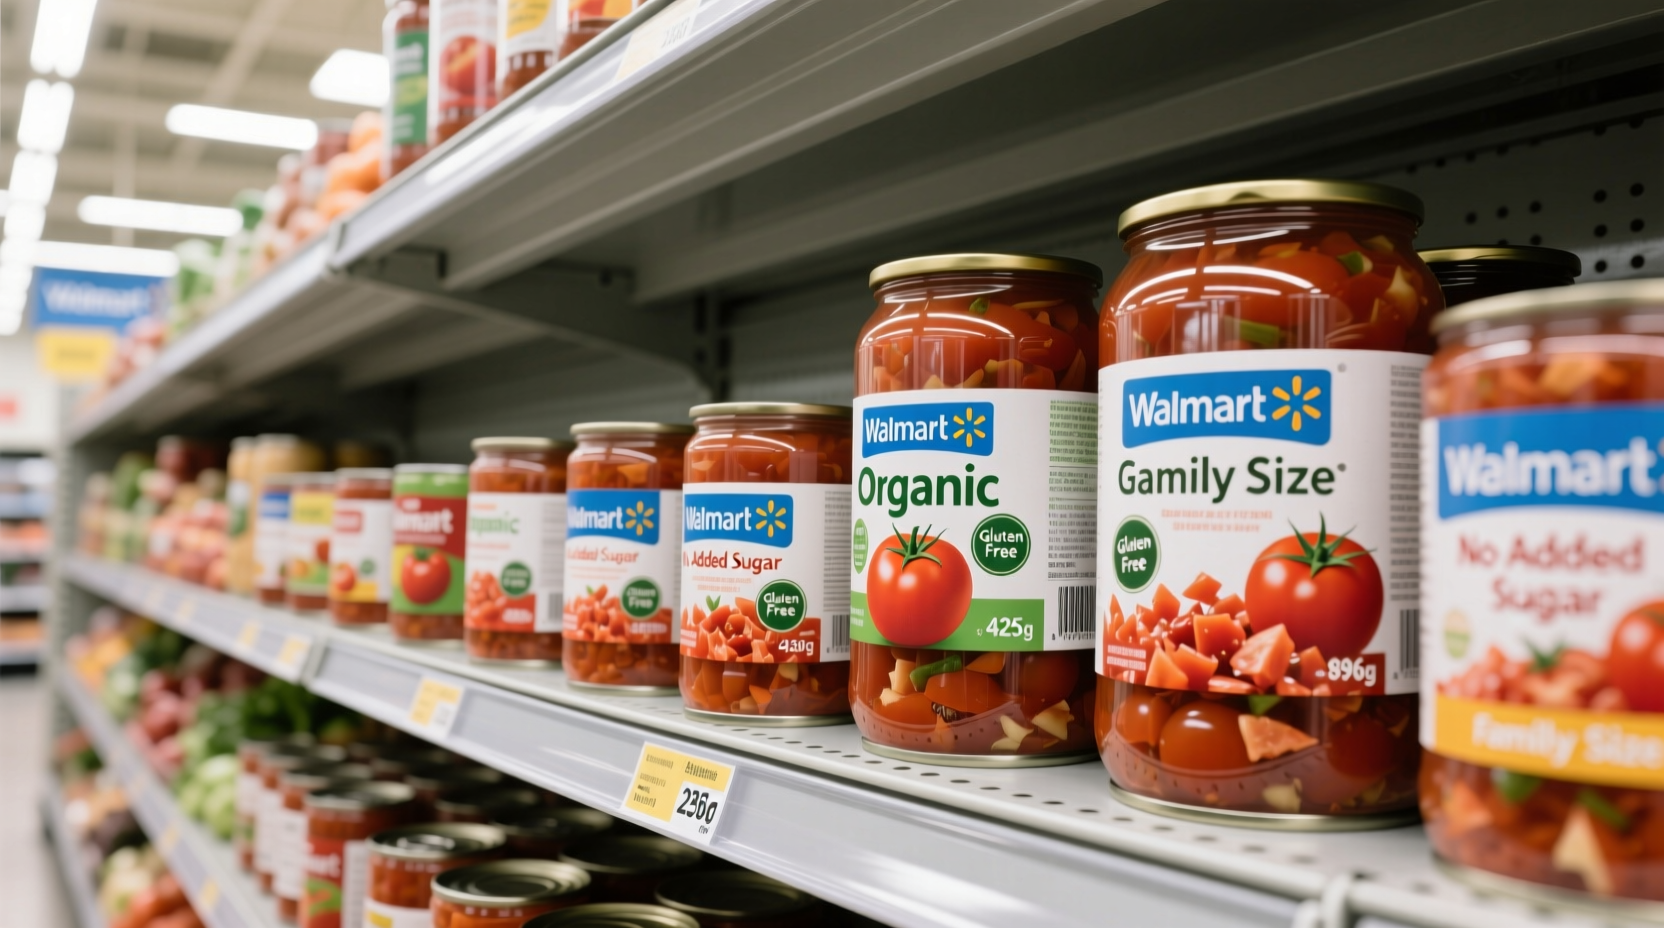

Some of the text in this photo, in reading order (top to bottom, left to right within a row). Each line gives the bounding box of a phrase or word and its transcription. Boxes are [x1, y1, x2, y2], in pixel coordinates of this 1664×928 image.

[1129, 385, 1266, 427] Walmart
[865, 414, 948, 443] Walmart
[1118, 456, 1235, 504] Gamily
[1444, 436, 1657, 497] Walmart
[858, 463, 1000, 518] Organic
[979, 527, 1024, 543] Gluten
[692, 550, 728, 569] Added
[731, 552, 782, 575] Sugar
[985, 543, 1018, 558] Free
[1121, 556, 1147, 573] Free
[1508, 534, 1644, 573] Added
[766, 604, 796, 618] Free
[1491, 576, 1602, 624] Sugar
[985, 617, 1034, 641] 425g
[1327, 657, 1377, 687] 896g
